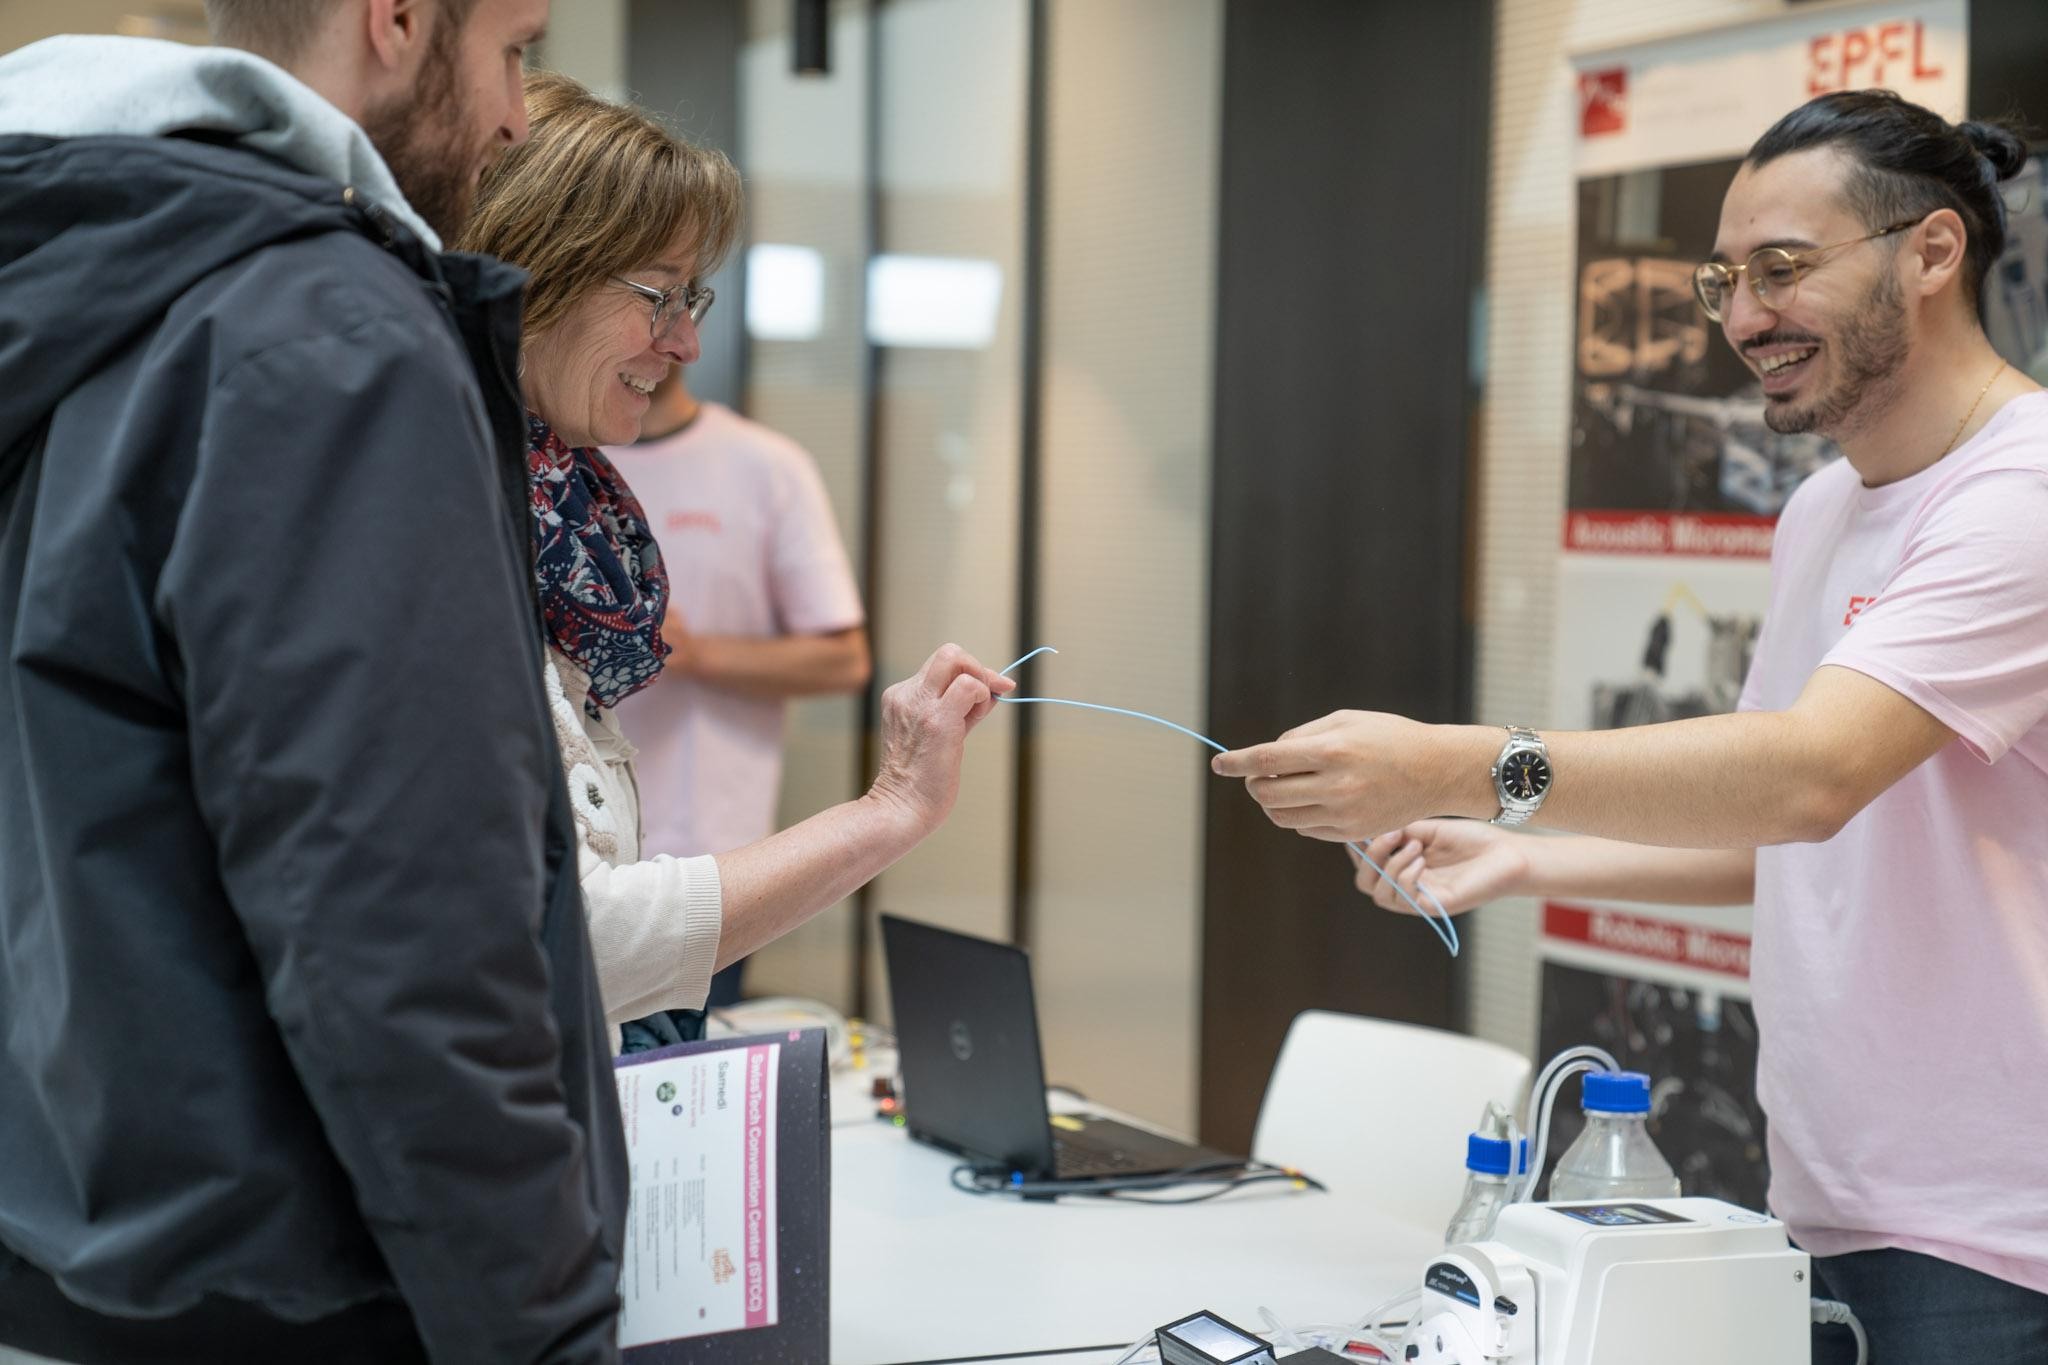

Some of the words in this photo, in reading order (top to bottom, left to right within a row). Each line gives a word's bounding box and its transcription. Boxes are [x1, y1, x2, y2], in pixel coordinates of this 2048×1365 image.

[1807, 20, 1943, 96] EPFL
[717, 1060, 729, 1110] Samedi
[749, 1053, 764, 1125] SwissTech
[749, 1127, 763, 1209] Convention
[749, 1210, 762, 1259] Center
